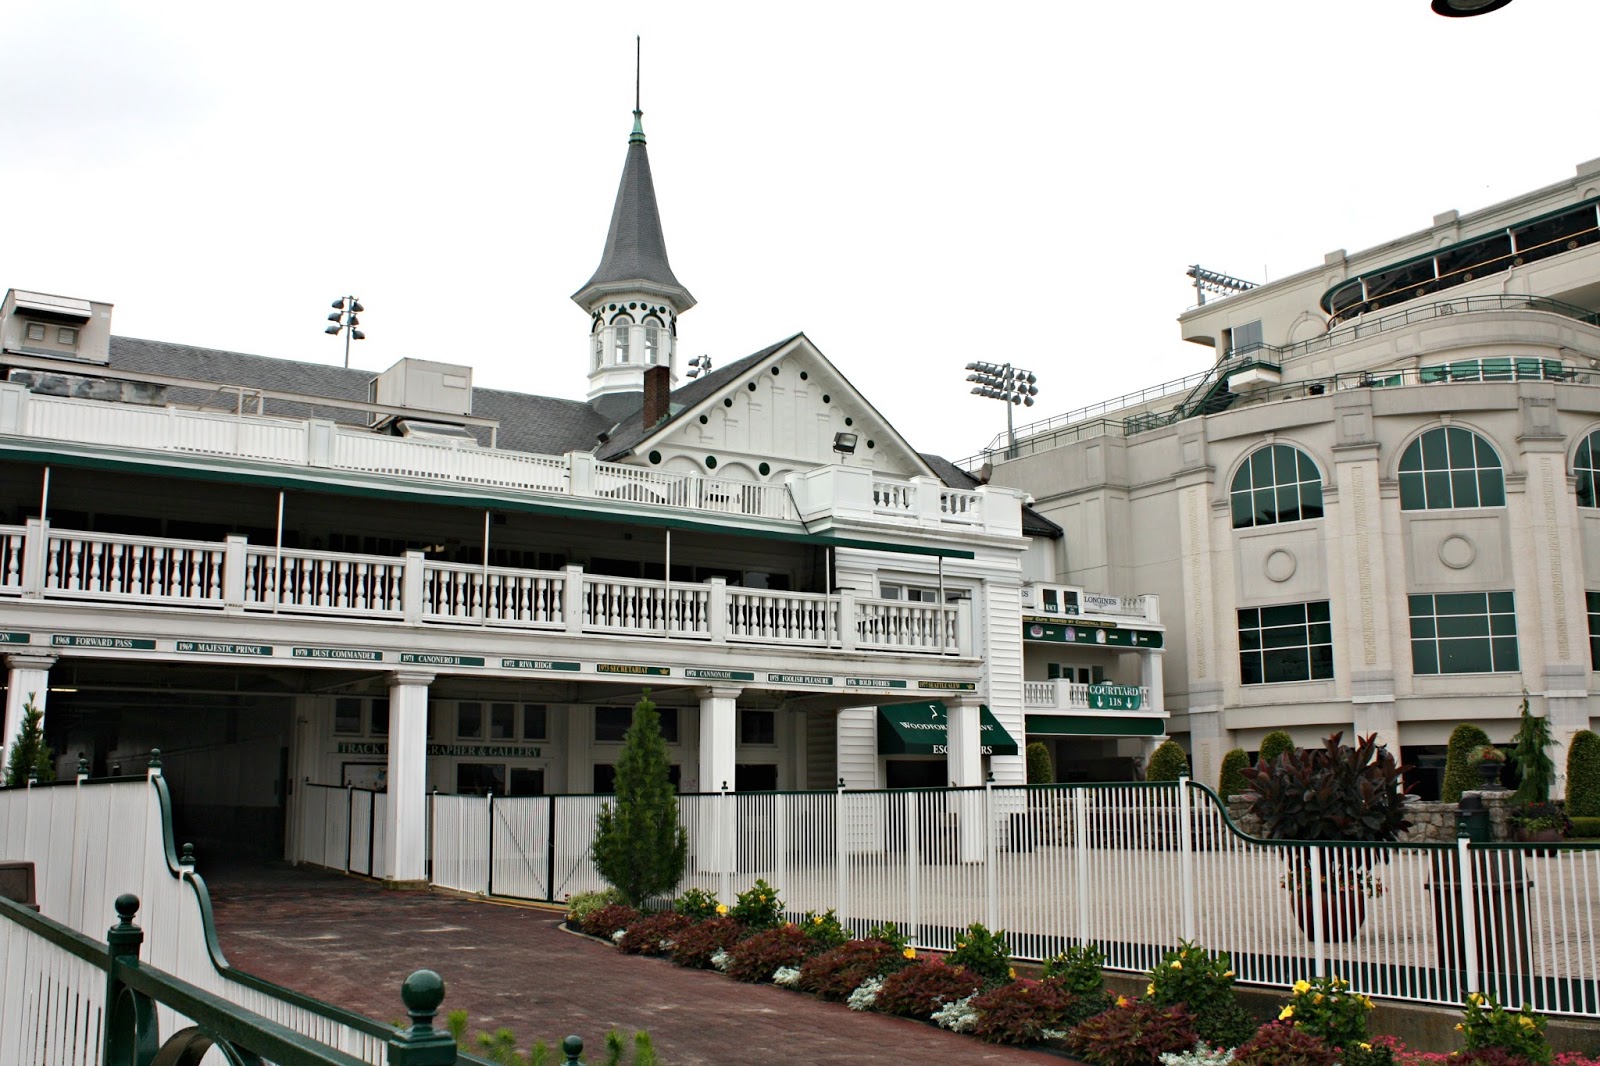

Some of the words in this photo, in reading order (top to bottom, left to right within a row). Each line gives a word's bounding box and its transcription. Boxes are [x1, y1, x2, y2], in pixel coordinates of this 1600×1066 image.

[1084, 596, 1117, 605] LONGINES
[55, 636, 70, 645] 1968
[75, 636, 113, 647] FORWARD
[114, 638, 133, 648] PASS
[179, 642, 193, 651] 1969
[198, 643, 234, 653] MAJESTIC
[236, 645, 262, 655] PRINCE
[295, 648, 308, 656] 1970
[312, 649, 330, 658] DUST
[331, 650, 376, 660] COMMANDER
[403, 654, 414, 662] 1971
[418, 655, 453, 664] CANONERO
[519, 660, 533, 668] RIVA
[534, 661, 553, 669] RIDGE
[609, 665, 648, 674] SECRETARIAT
[700, 670, 732, 679] CANNONADE
[782, 675, 803, 683] FOOLISH
[804, 676, 829, 684] PLEASURE
[1089, 685, 1139, 696] COURTYARD
[1109, 697, 1122, 706] 118
[899, 721, 948, 731] WOODFOR
[340, 743, 381, 753] TRACK
[478, 746, 486, 756] &
[489, 746, 540, 757] GALLERY
